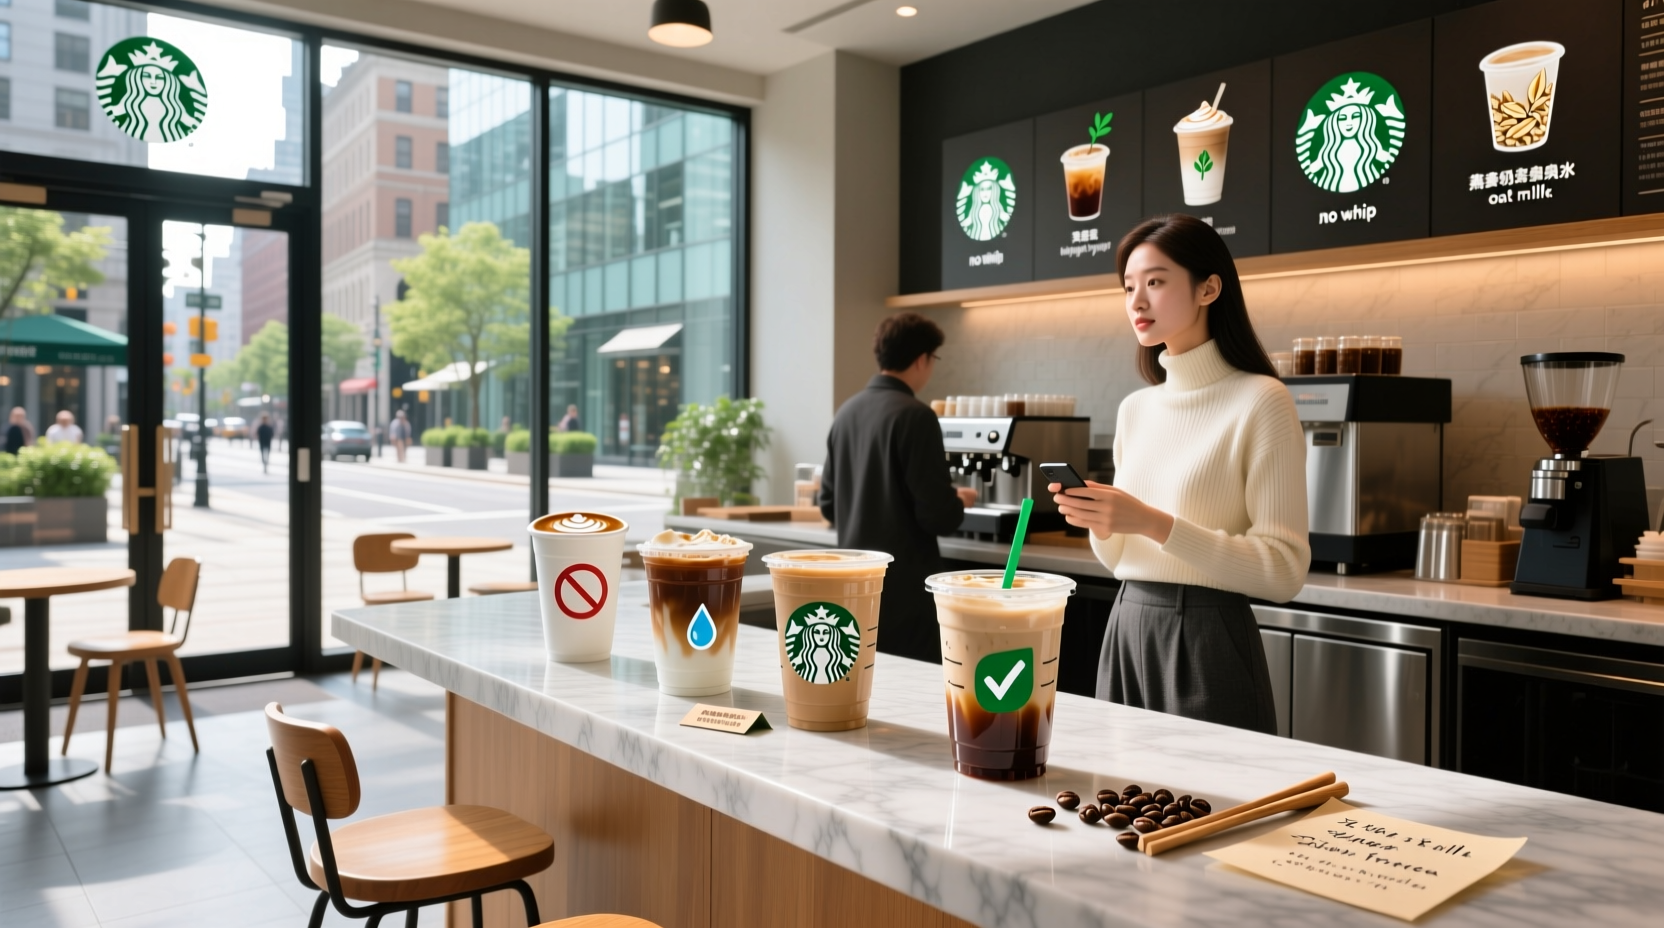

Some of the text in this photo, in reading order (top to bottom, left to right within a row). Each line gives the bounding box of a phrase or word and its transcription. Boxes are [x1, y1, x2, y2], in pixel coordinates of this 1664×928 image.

[1319, 203, 1377, 225] no whip
[969, 255, 982, 267] no
